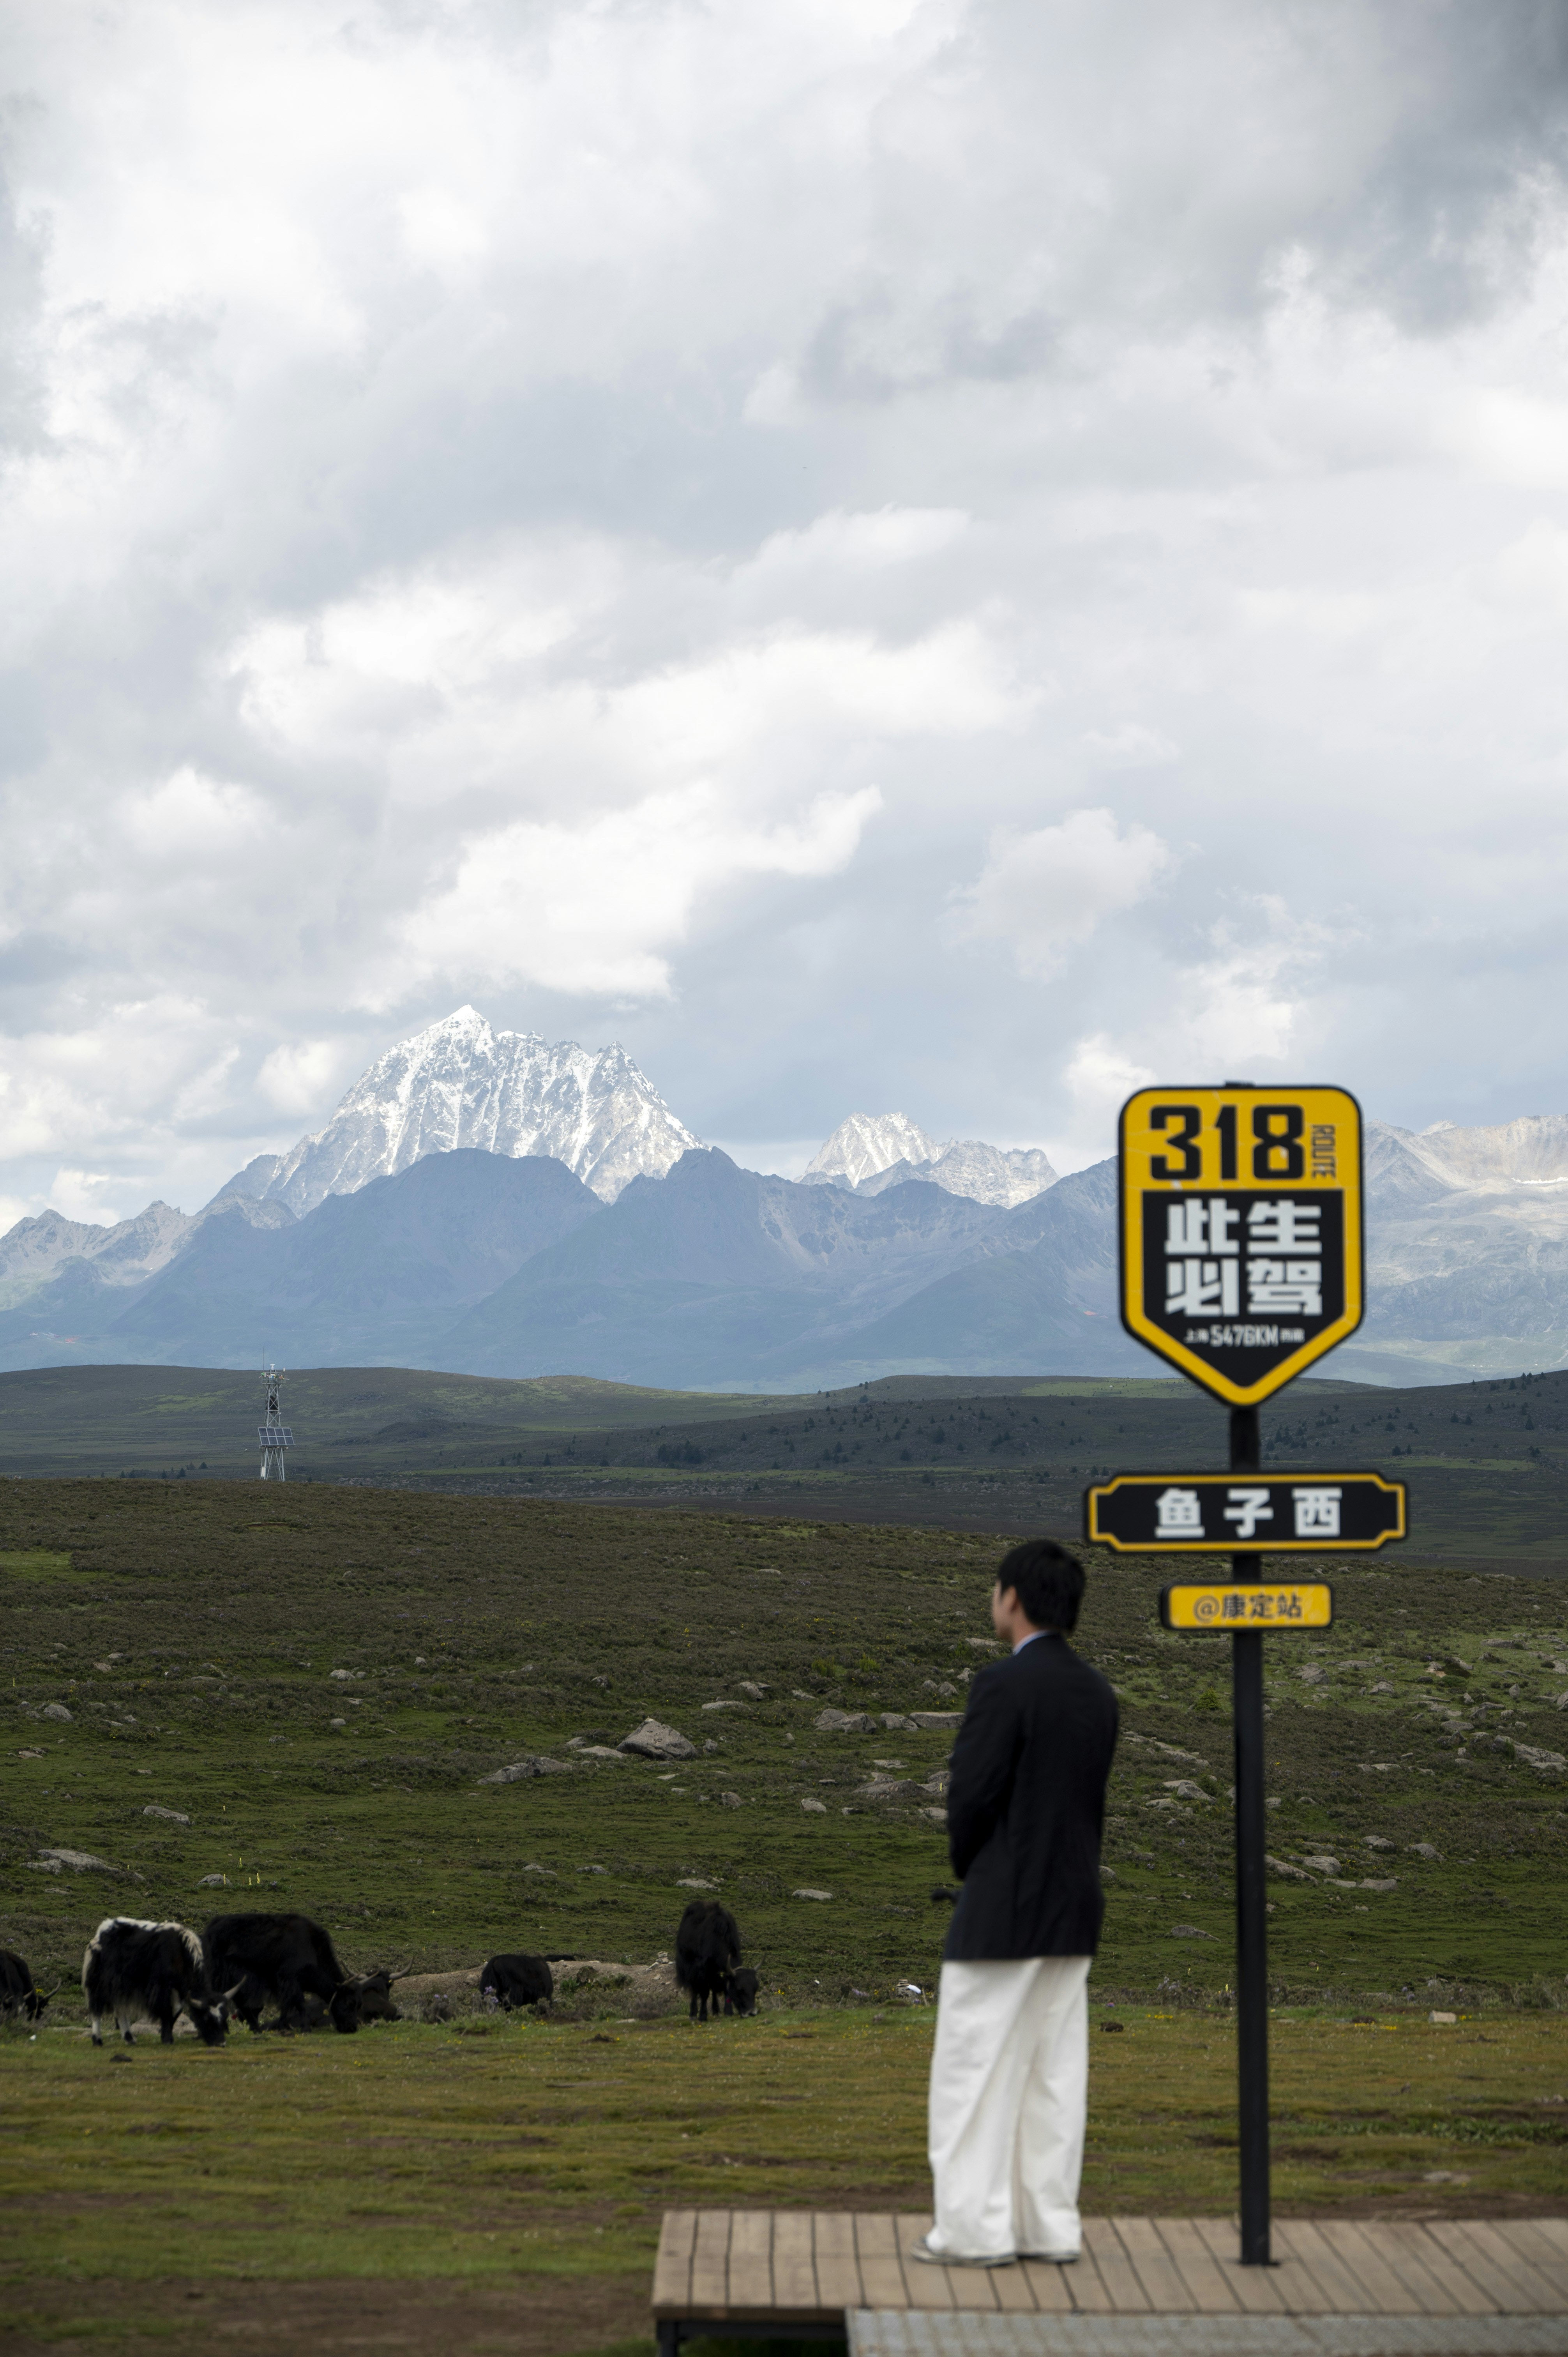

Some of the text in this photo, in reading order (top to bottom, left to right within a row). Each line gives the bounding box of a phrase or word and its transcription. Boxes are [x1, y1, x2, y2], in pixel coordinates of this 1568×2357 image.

[1149, 1104, 1304, 1180] 318
[1312, 1124, 1336, 1179] ROUTE
[1165, 1199, 1322, 1254] 此生
[1165, 1258, 1323, 1316] 必驾
[1210, 1324, 1278, 1347] 5476KM
[1155, 1488, 1342, 1537] 鱼子西
[1193, 1593, 1303, 1623] @康定站
